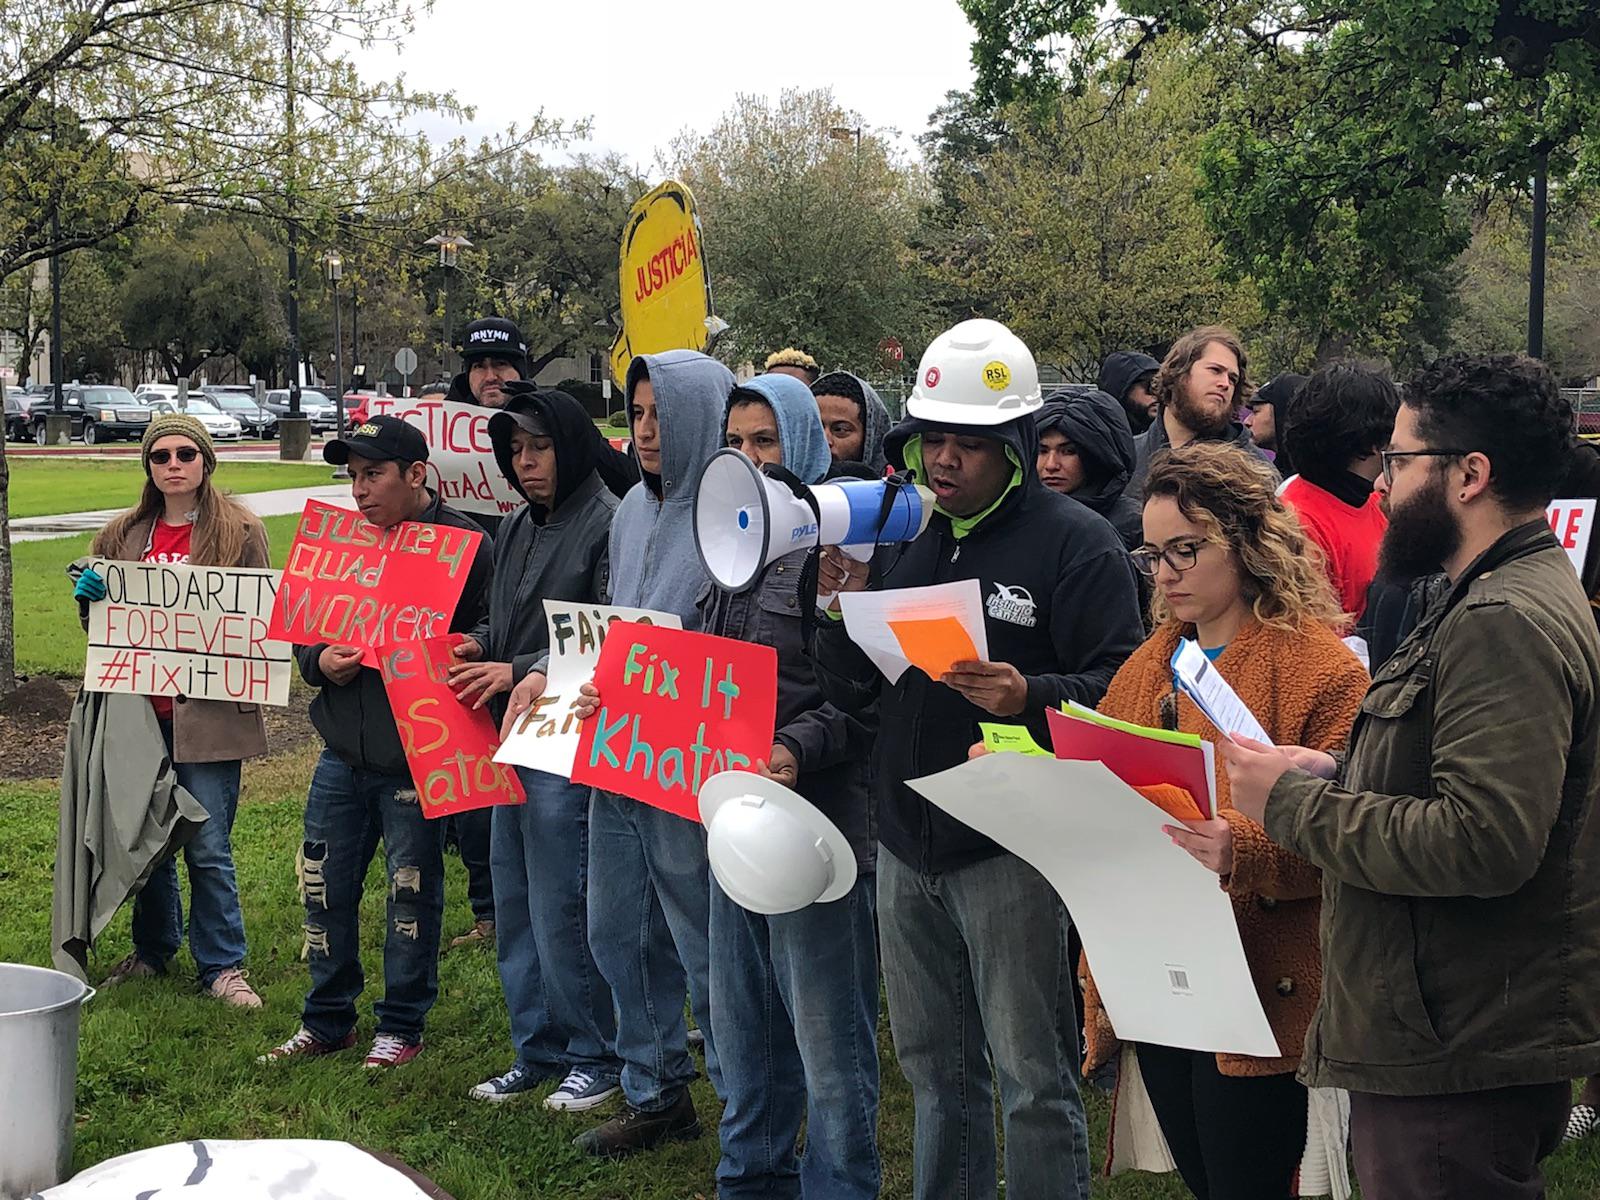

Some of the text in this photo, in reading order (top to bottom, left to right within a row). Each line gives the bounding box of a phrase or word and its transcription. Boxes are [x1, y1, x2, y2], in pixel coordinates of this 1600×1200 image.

[635, 229, 698, 303] JUSTICIA
[470, 329, 510, 343] JRNYMN
[986, 367, 1008, 380] RSL
[437, 533, 470, 578] 4
[107, 606, 268, 659] FOREVER
[623, 642, 681, 701] Fix
